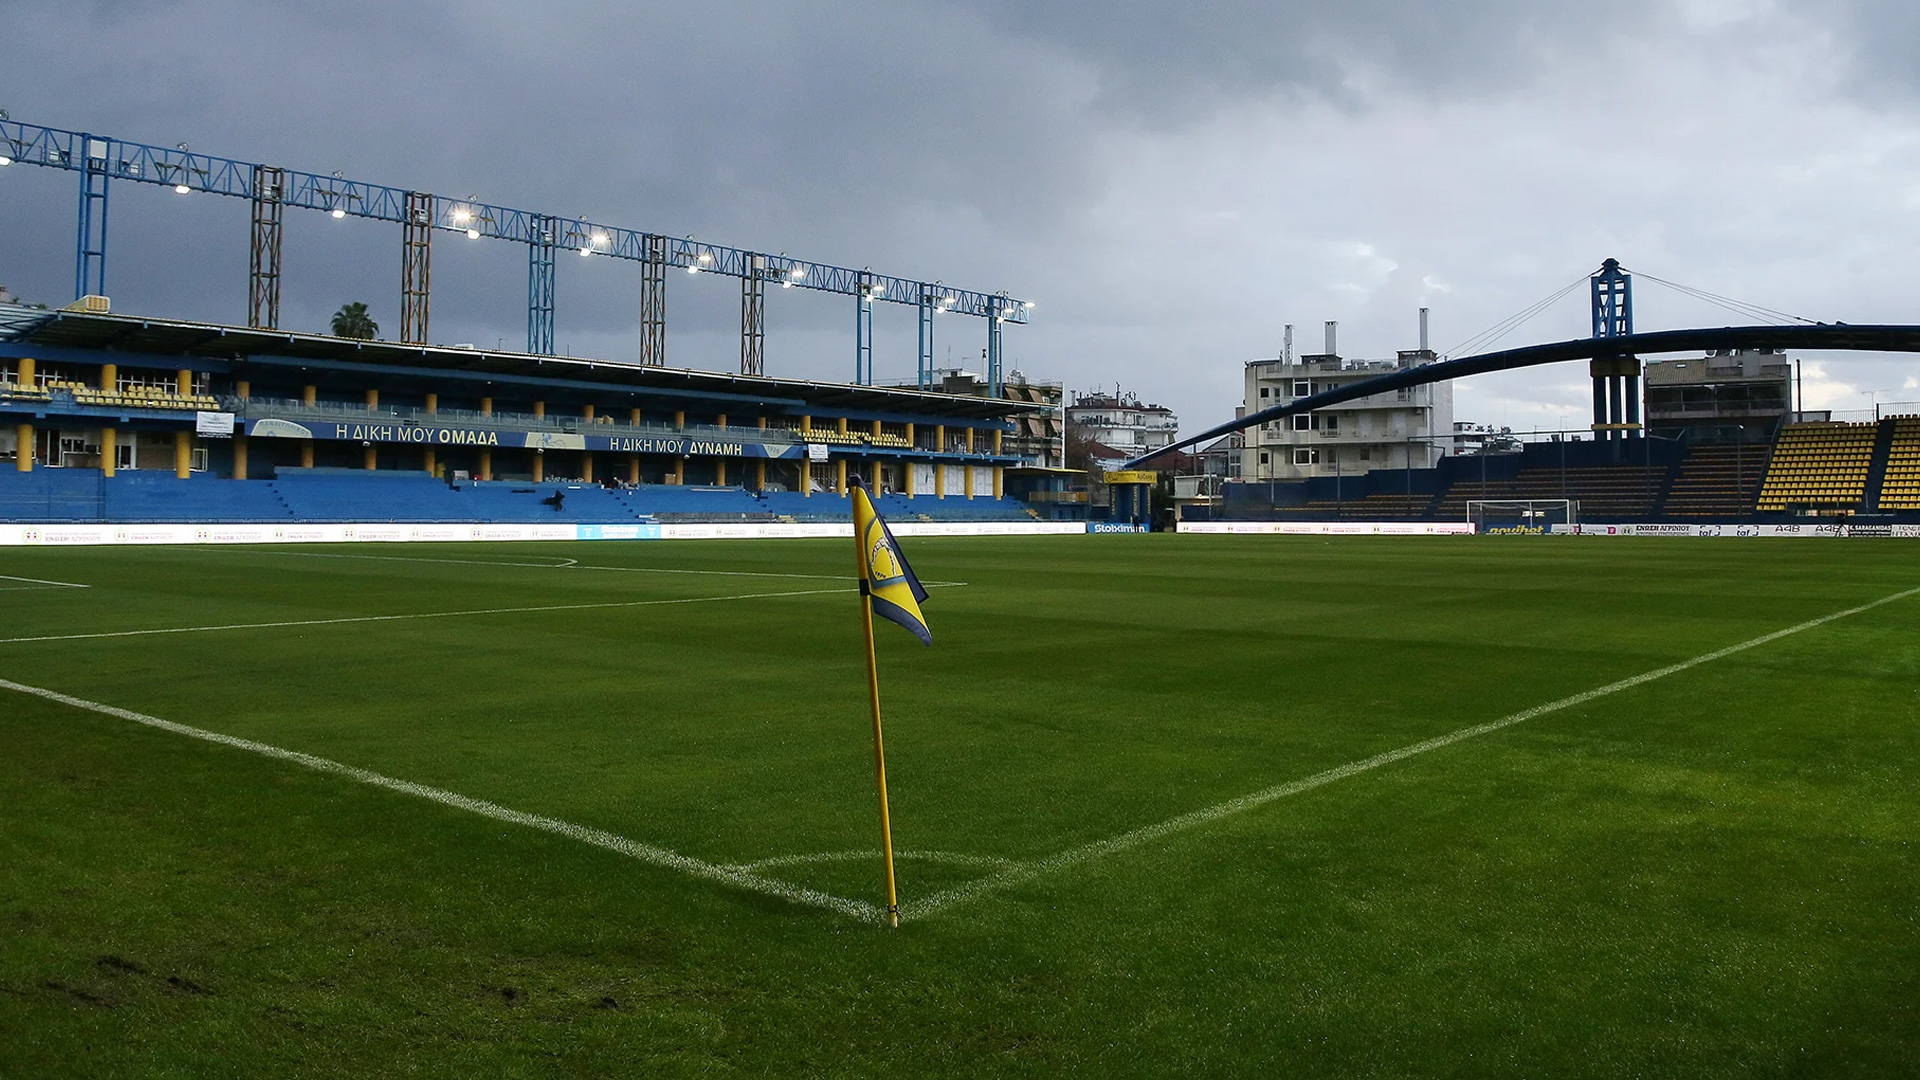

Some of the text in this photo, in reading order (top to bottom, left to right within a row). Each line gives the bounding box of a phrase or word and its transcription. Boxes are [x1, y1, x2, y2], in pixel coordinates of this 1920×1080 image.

[336, 424, 498, 445] Η ΔΙΚΗ ΜΟΥ ΟΜΑΔΑ
[610, 438, 742, 456] Η ΔΙΚΗ ΜΟΥ ΔΥΝΑΜΗ
